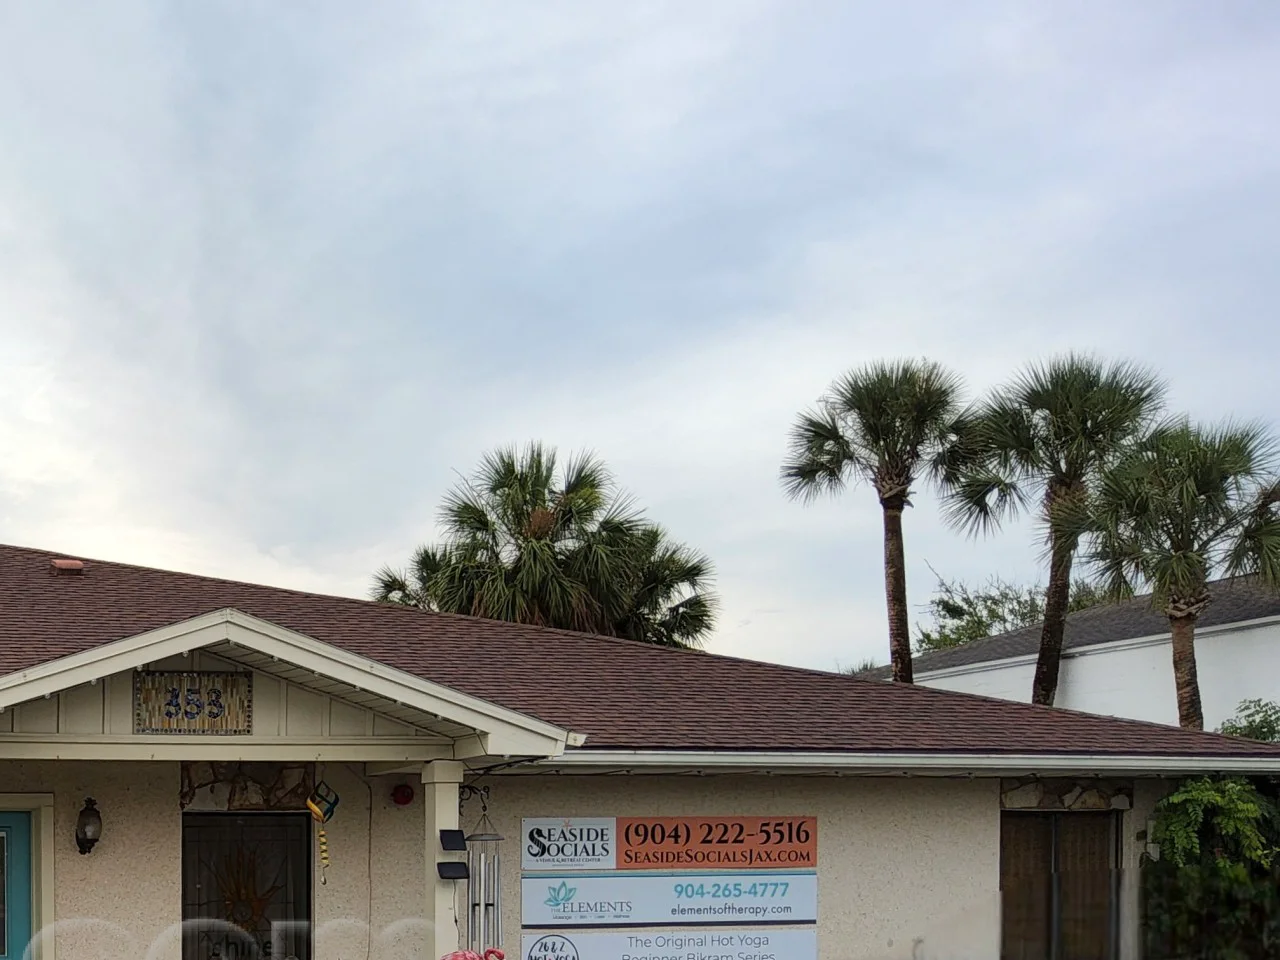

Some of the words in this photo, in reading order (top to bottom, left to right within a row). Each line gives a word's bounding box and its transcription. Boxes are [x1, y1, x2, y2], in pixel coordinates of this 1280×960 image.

[164, 687, 224, 719] 353
[624, 823, 690, 847] (904)
[700, 821, 810, 844] 222-5516
[674, 882, 789, 898] 904-265-4777
[562, 901, 632, 913] ELEMENTS
[671, 902, 792, 917] elementsoftherapy.com
[539, 942, 549, 952] 26
[628, 936, 651, 948] The
[655, 936, 706, 951] Original
[711, 936, 734, 946] Hot
[737, 935, 769, 950] Yoga
